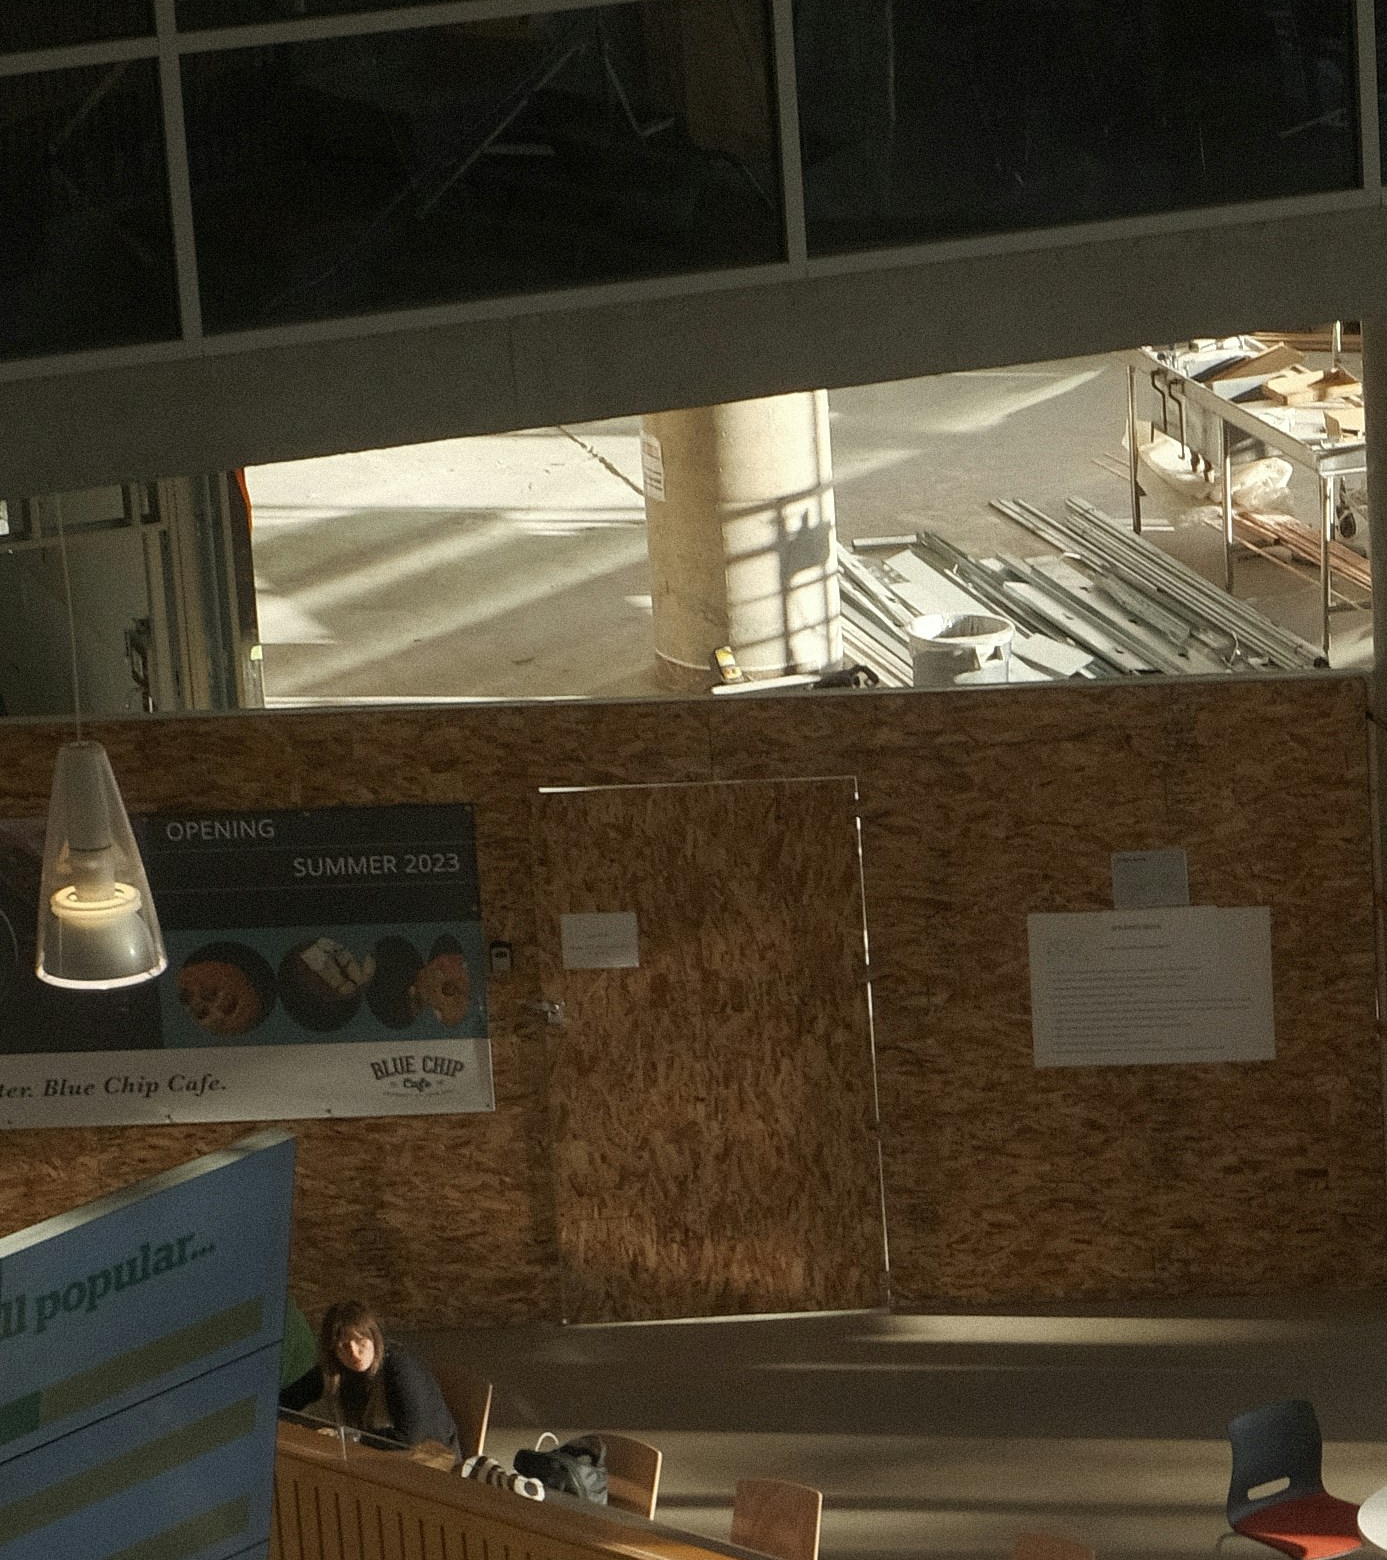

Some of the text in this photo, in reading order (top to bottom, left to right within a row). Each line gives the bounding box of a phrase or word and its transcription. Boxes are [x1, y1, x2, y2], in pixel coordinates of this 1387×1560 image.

[166, 819, 276, 841] OPENING
[293, 853, 460, 877] SUMMER 2023
[370, 1055, 464, 1080] BLUE CHIP
[0, 1073, 227, 1098] ter. Blue Chip Cafe.
